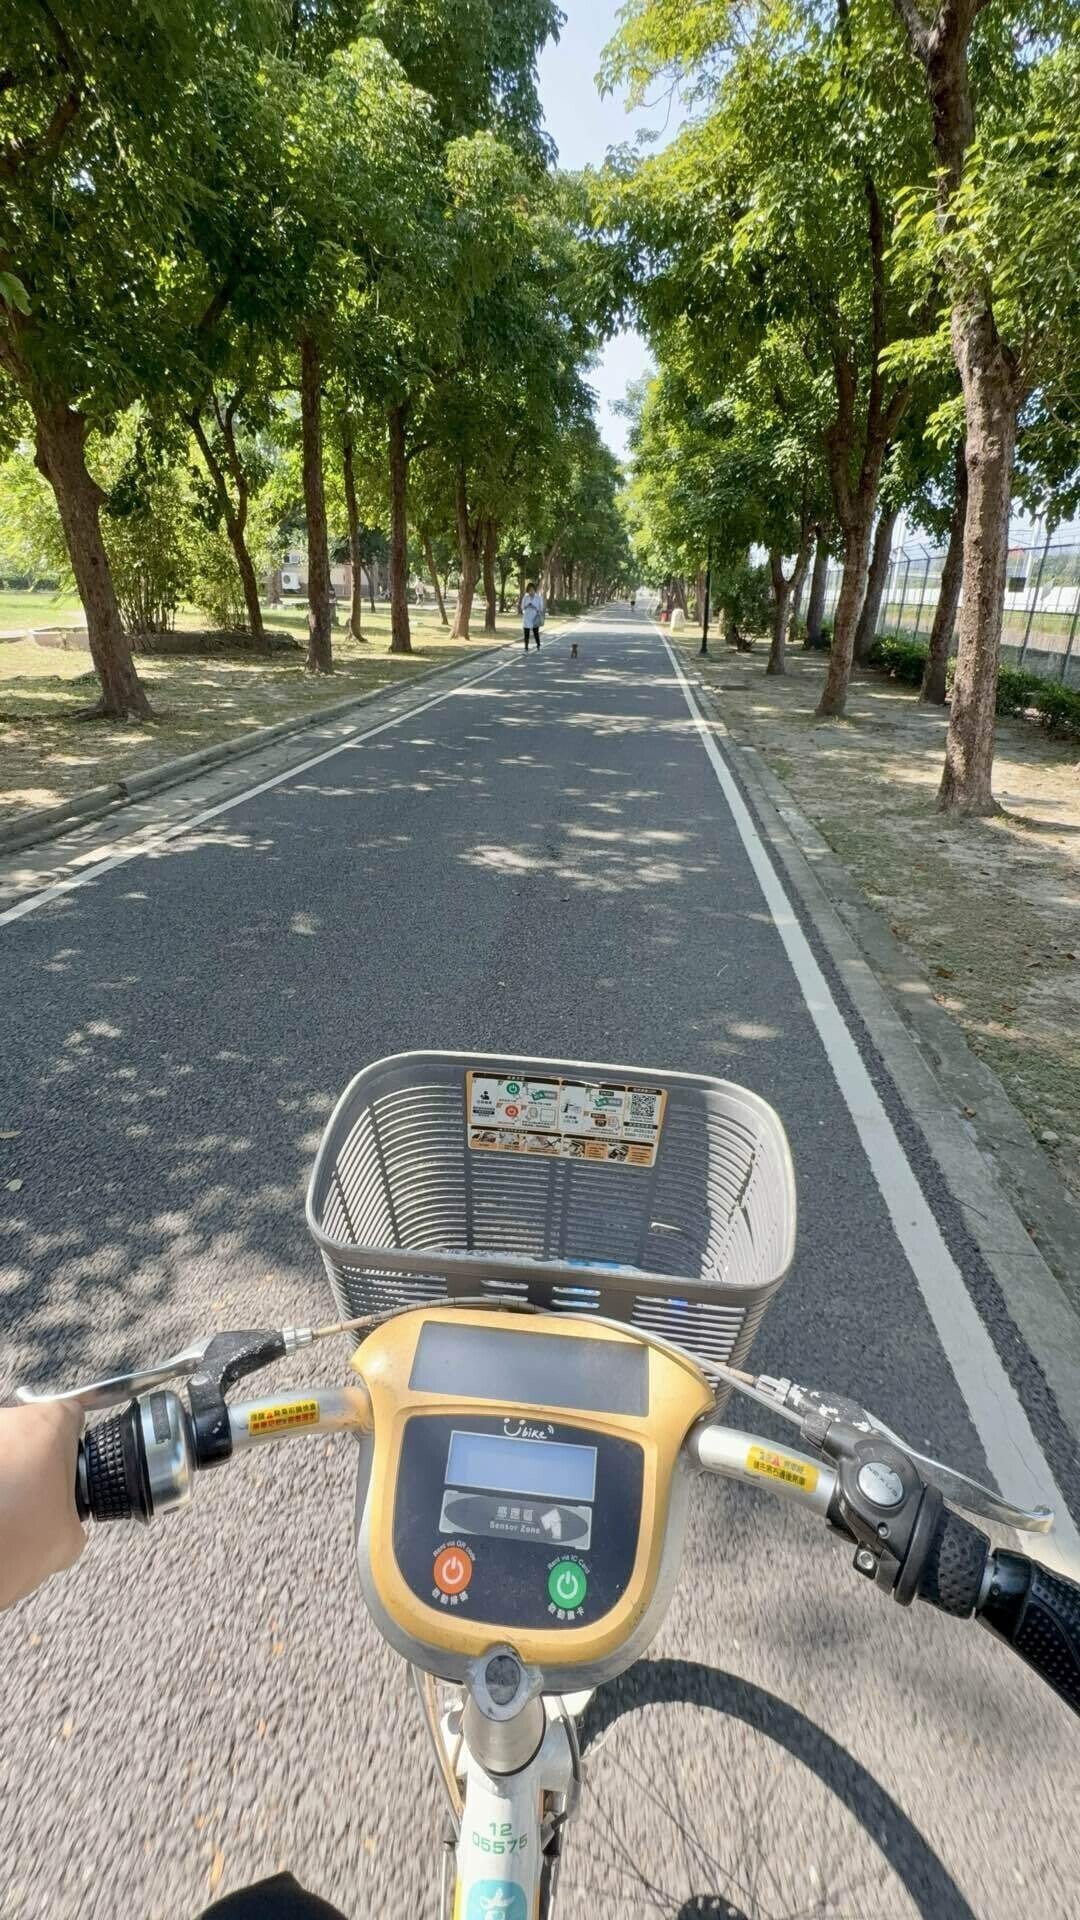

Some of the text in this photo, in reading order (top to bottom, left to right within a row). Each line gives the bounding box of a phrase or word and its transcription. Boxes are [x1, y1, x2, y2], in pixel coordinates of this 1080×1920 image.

[489, 1521, 541, 1535] Sensor Zone
[489, 1822, 513, 1837] 12
[472, 1831, 528, 1855] 05575
